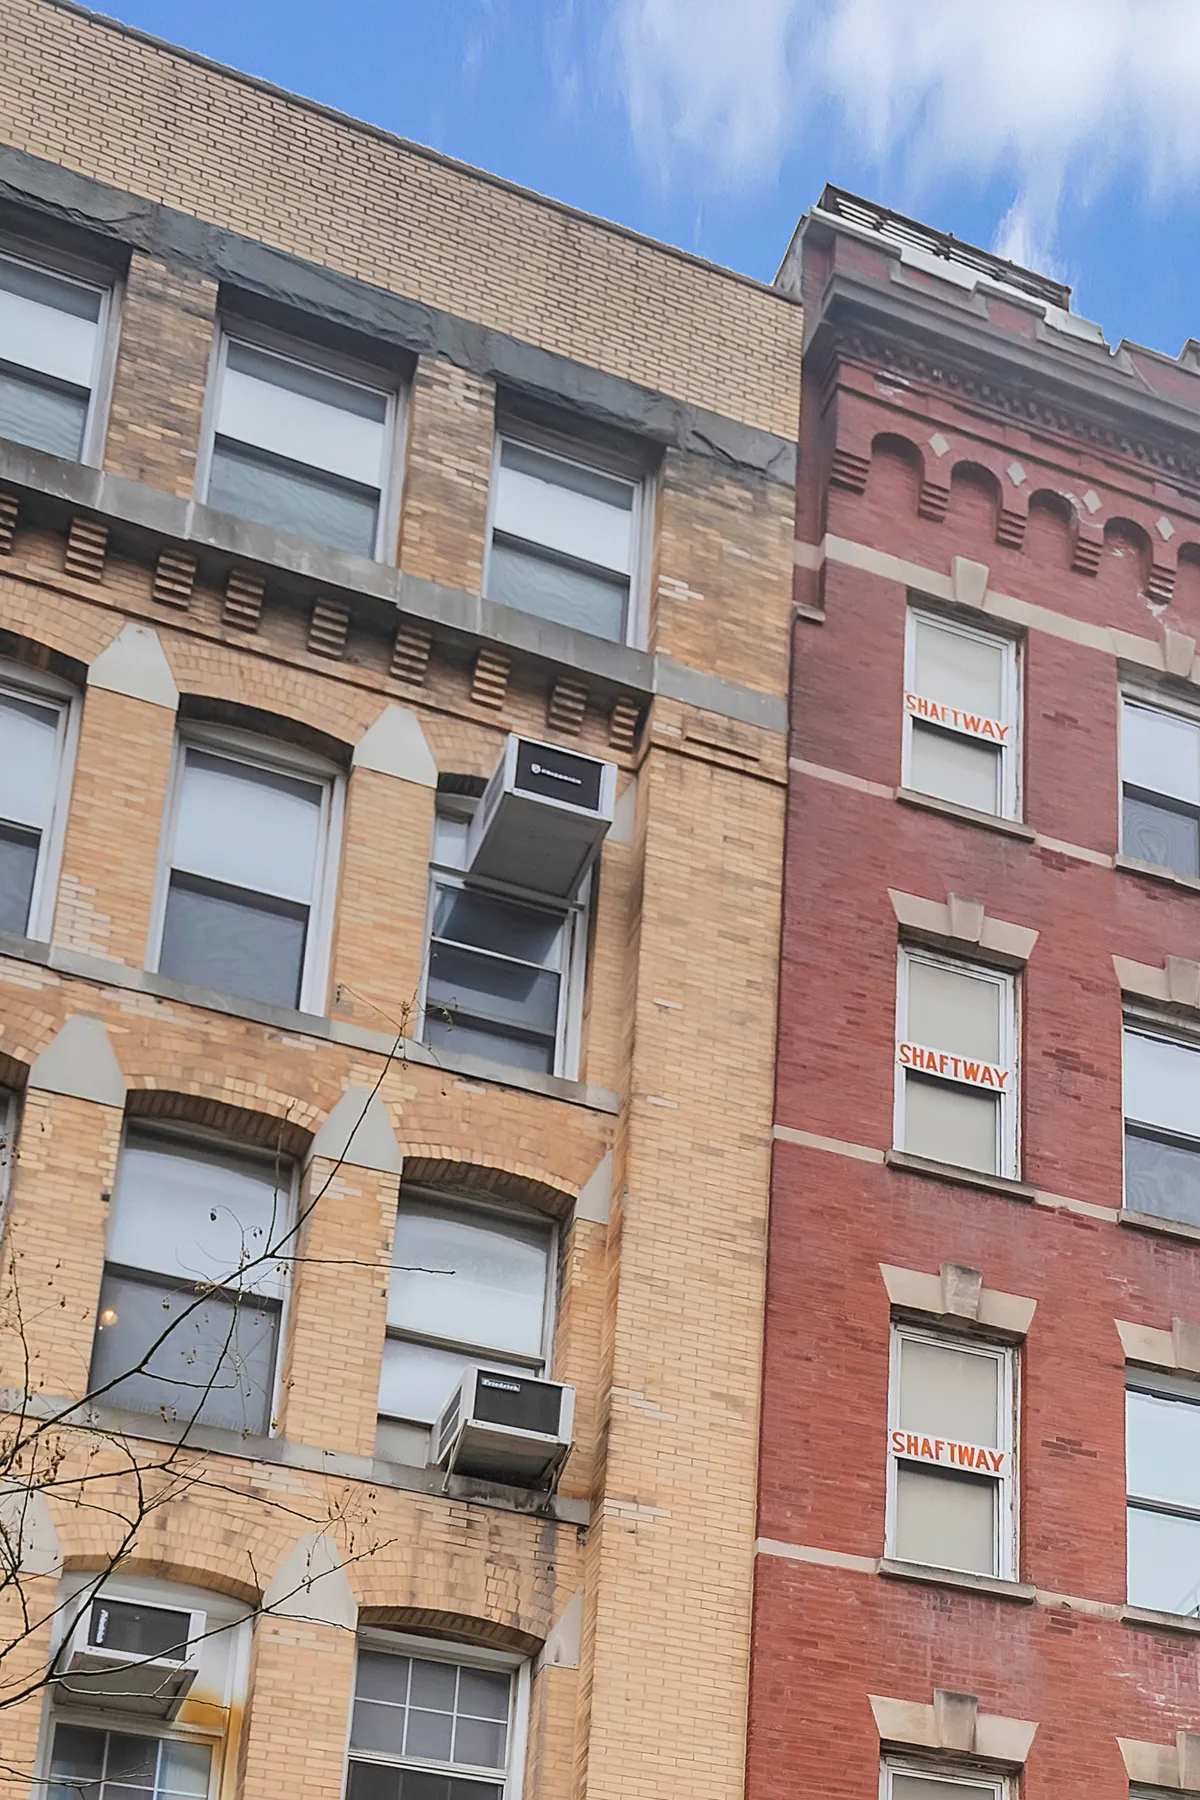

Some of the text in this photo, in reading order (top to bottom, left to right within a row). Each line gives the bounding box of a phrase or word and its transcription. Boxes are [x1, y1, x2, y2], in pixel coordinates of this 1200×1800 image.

[905, 693, 1009, 741] SHAFTWAY
[899, 1043, 1009, 1089] SHAFTWAY
[892, 1431, 1005, 1473] SHAFTWAY
